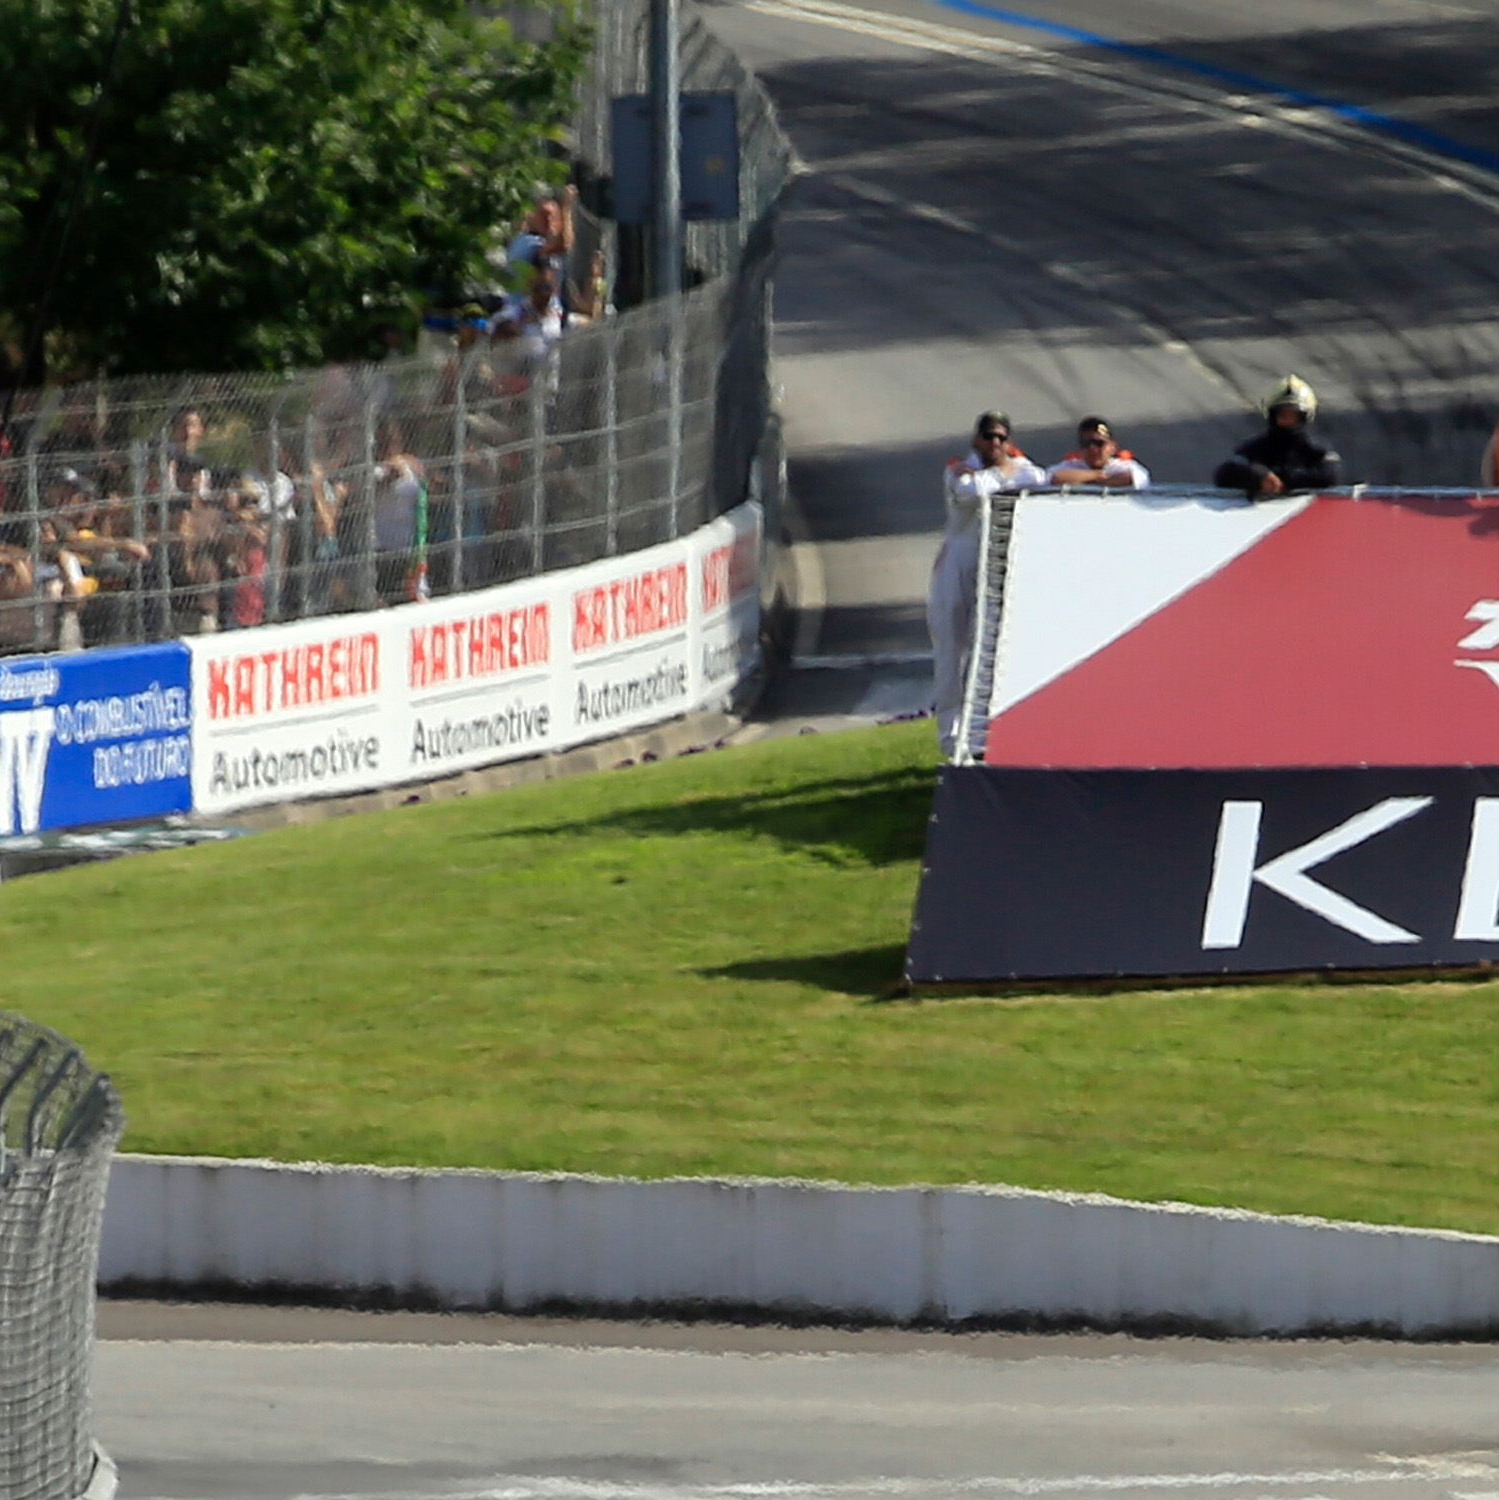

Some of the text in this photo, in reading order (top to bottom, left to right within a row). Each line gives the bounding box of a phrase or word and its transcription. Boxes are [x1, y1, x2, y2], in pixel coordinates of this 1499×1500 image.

[576, 657, 687, 724] Automotive
[209, 728, 380, 794] Automotive
[410, 696, 550, 763] Automotive
